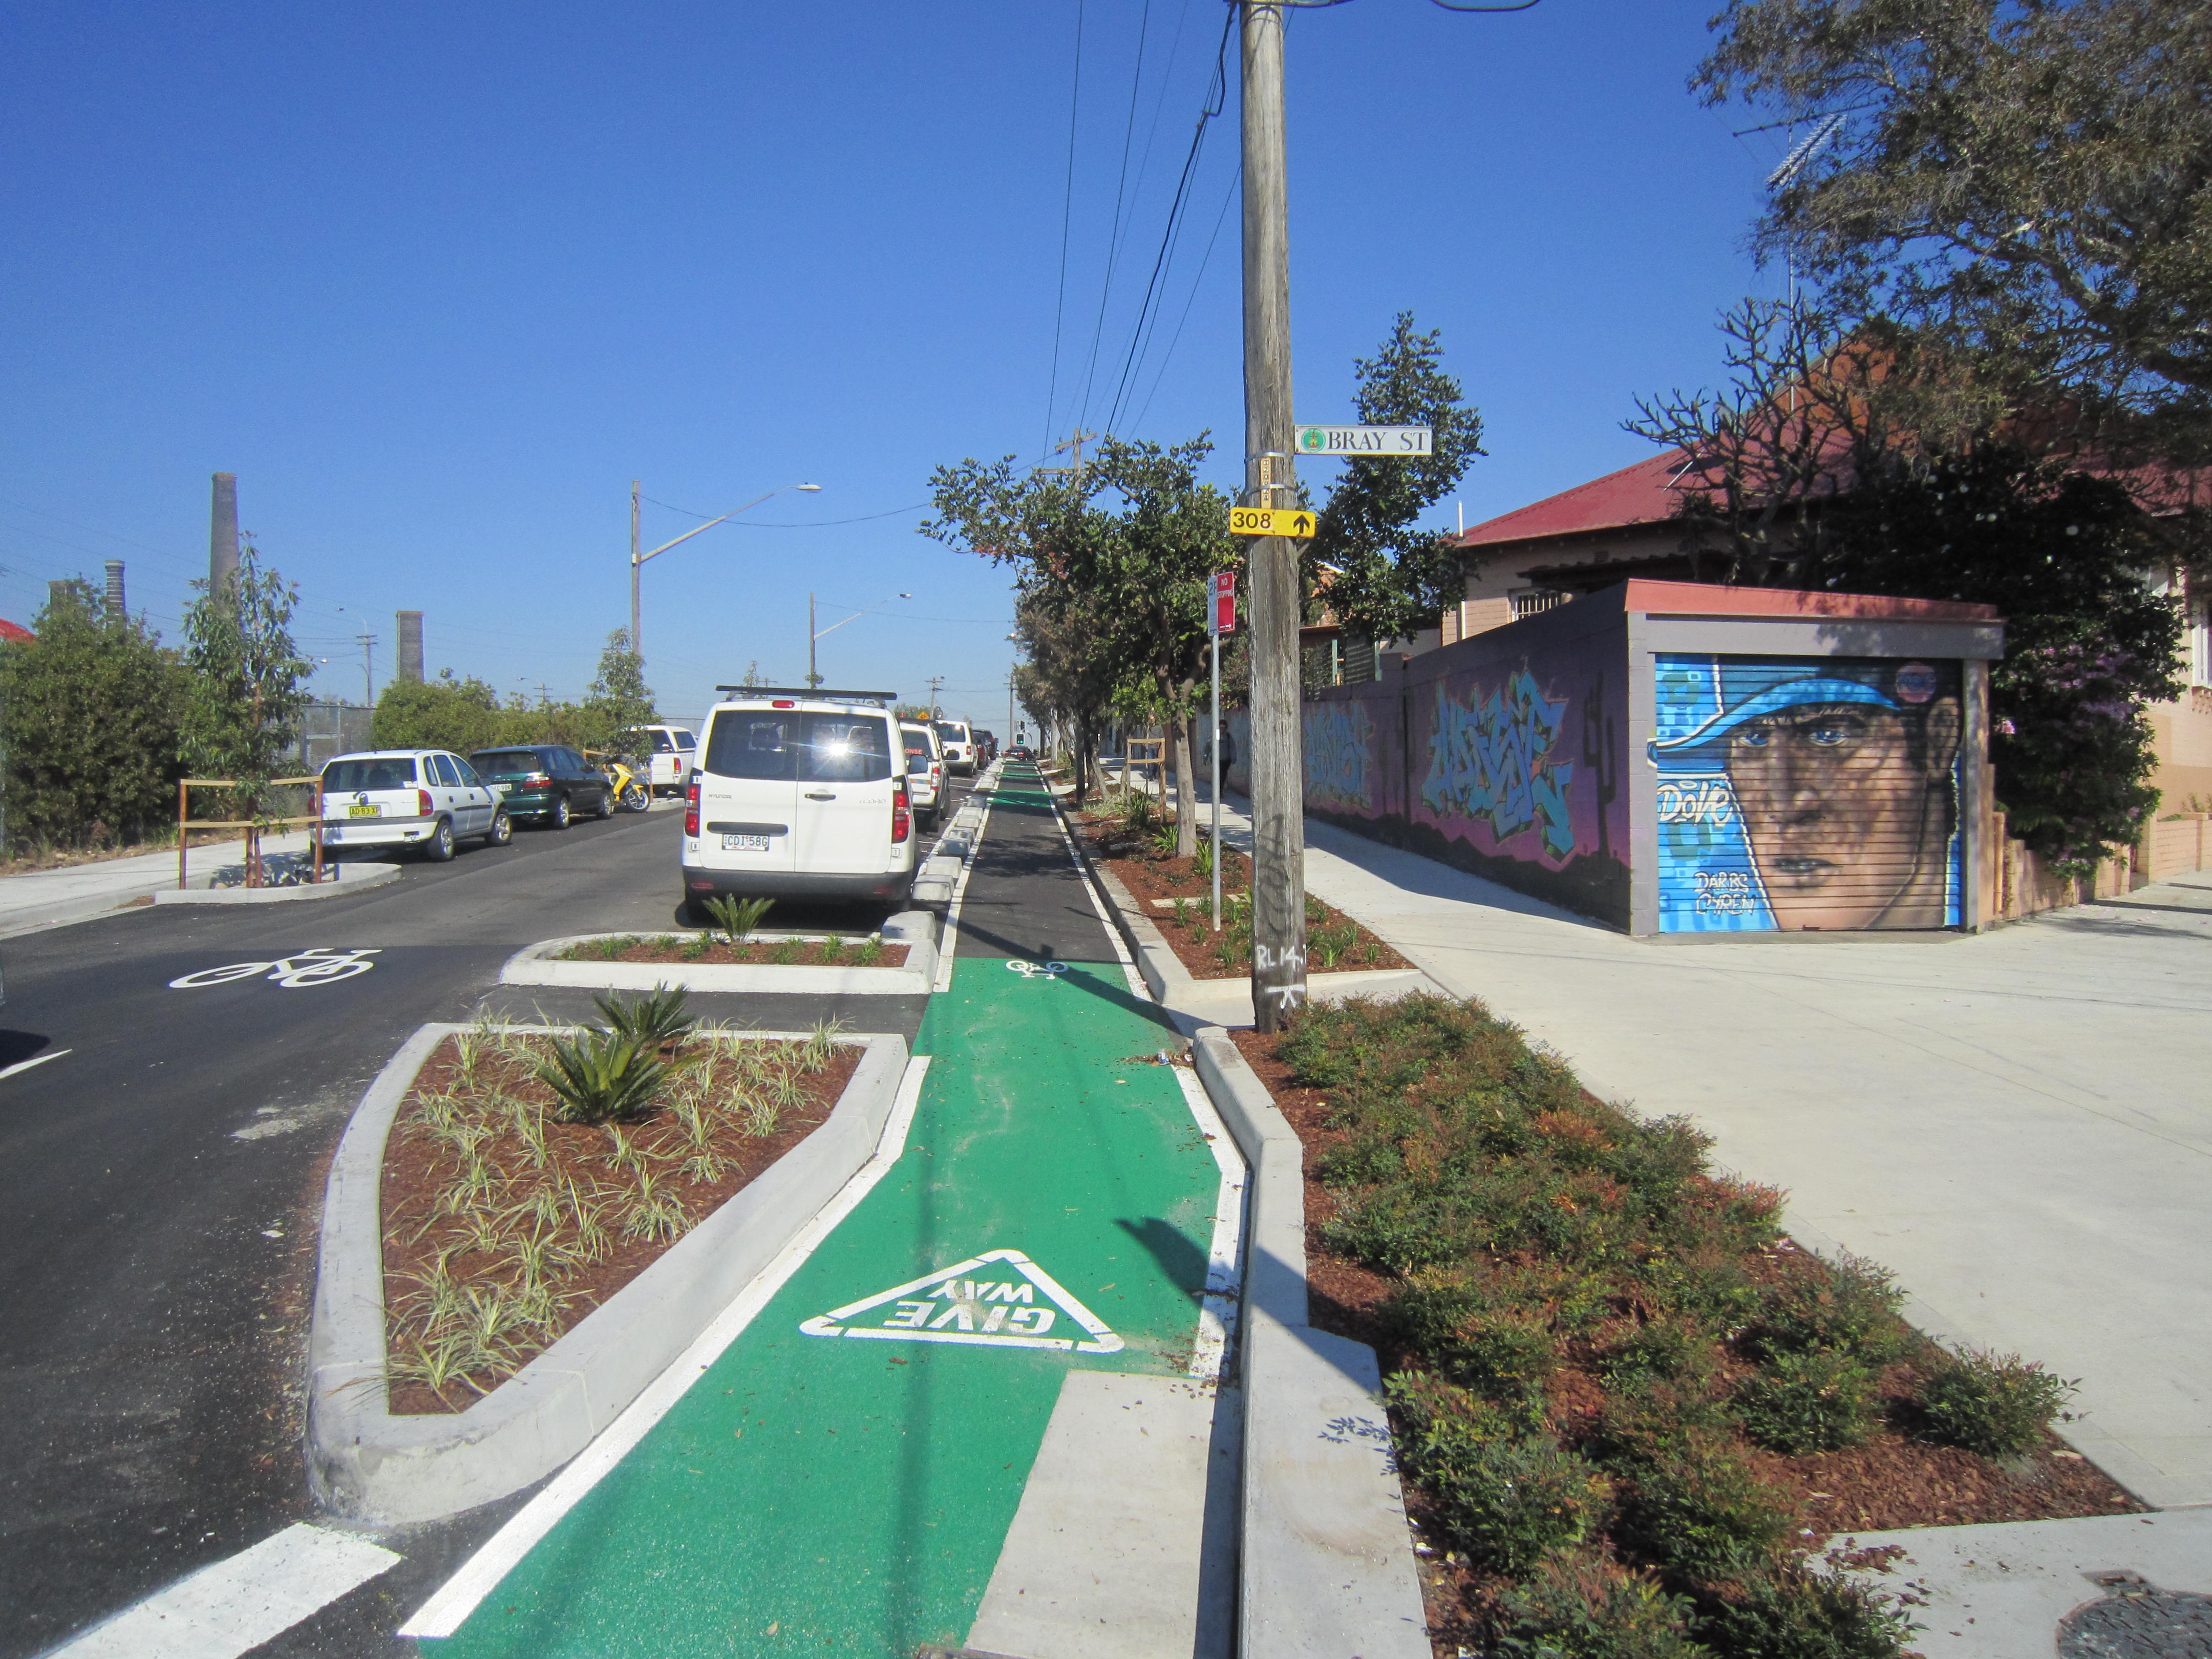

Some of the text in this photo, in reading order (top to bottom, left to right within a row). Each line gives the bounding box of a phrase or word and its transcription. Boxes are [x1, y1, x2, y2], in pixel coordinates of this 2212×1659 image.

[1328, 431, 1428, 451] BRAY ST
[1232, 512, 1271, 529] 308
[1694, 871, 1749, 892] DARBS
[1256, 944, 1276, 969] RL
[928, 1280, 1033, 1303] WAY
[883, 1301, 1056, 1334] GIVE
